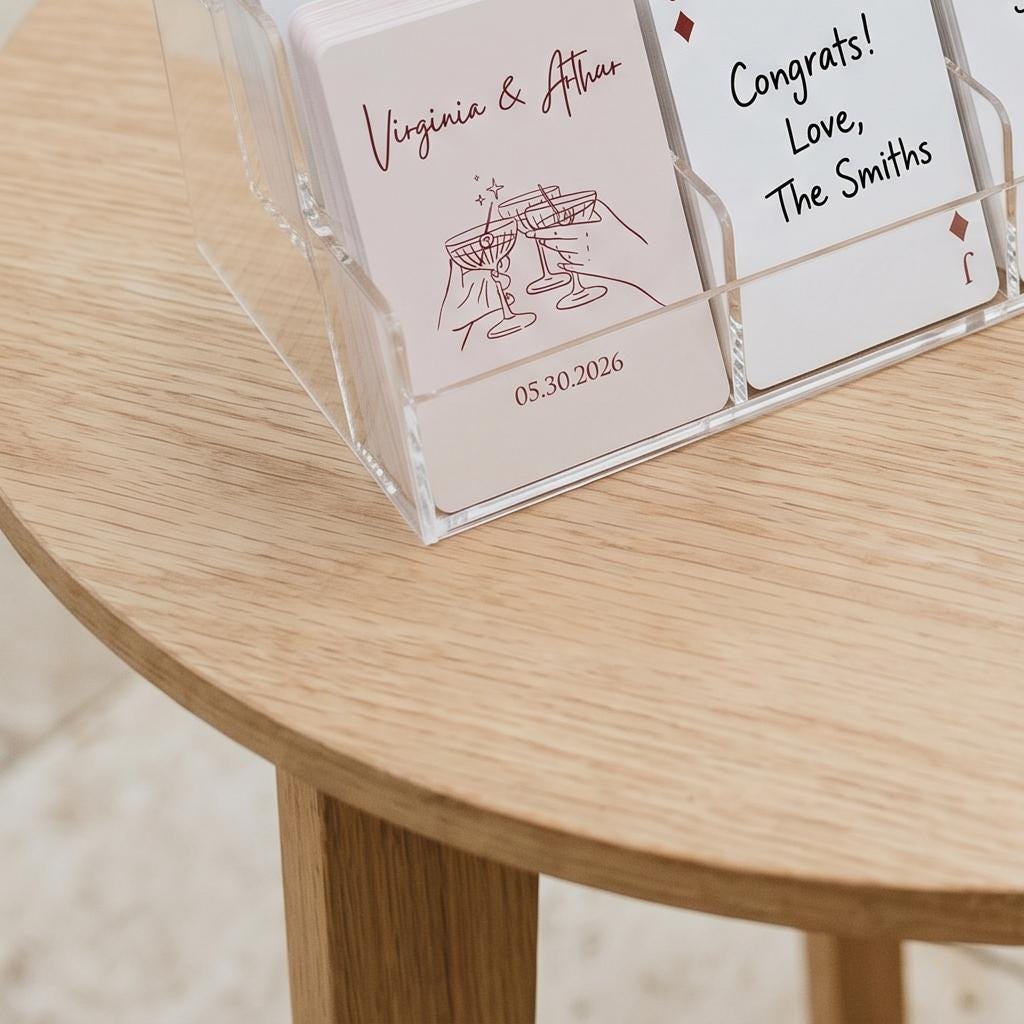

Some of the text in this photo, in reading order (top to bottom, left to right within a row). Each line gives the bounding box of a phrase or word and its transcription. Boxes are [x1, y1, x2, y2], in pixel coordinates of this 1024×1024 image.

[730, 12, 874, 108] Congrats!
[362, 48, 623, 172] Virginia & Arthur
[784, 110, 864, 156] Love,
[764, 136, 933, 224] The Smiths
[963, 251, 975, 286] J
[514, 351, 624, 406] 05.30.2026
